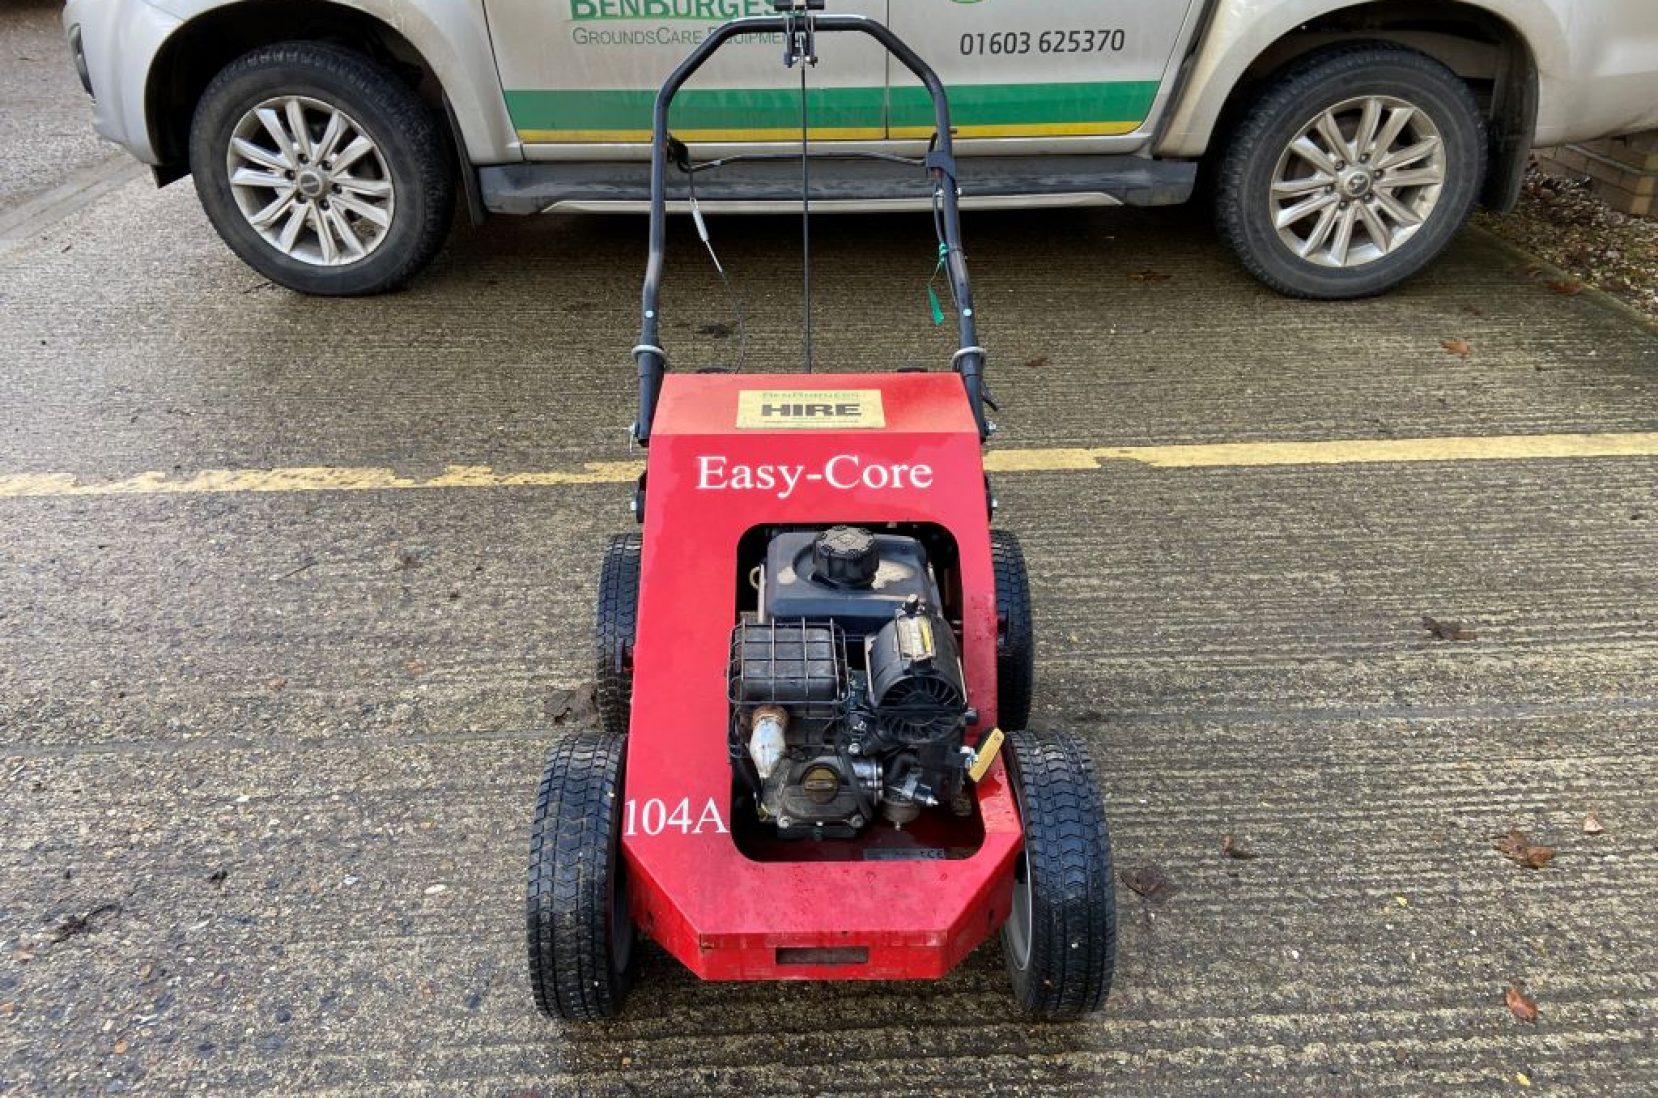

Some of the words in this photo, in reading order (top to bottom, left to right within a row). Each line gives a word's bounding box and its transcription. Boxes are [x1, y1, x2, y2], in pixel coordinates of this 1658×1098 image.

[959, 31, 1031, 55] 01603
[1038, 28, 1125, 53] 625370
[761, 403, 862, 417] HIRE
[696, 454, 934, 499] Easy-Core
[623, 796, 730, 836] 104A
